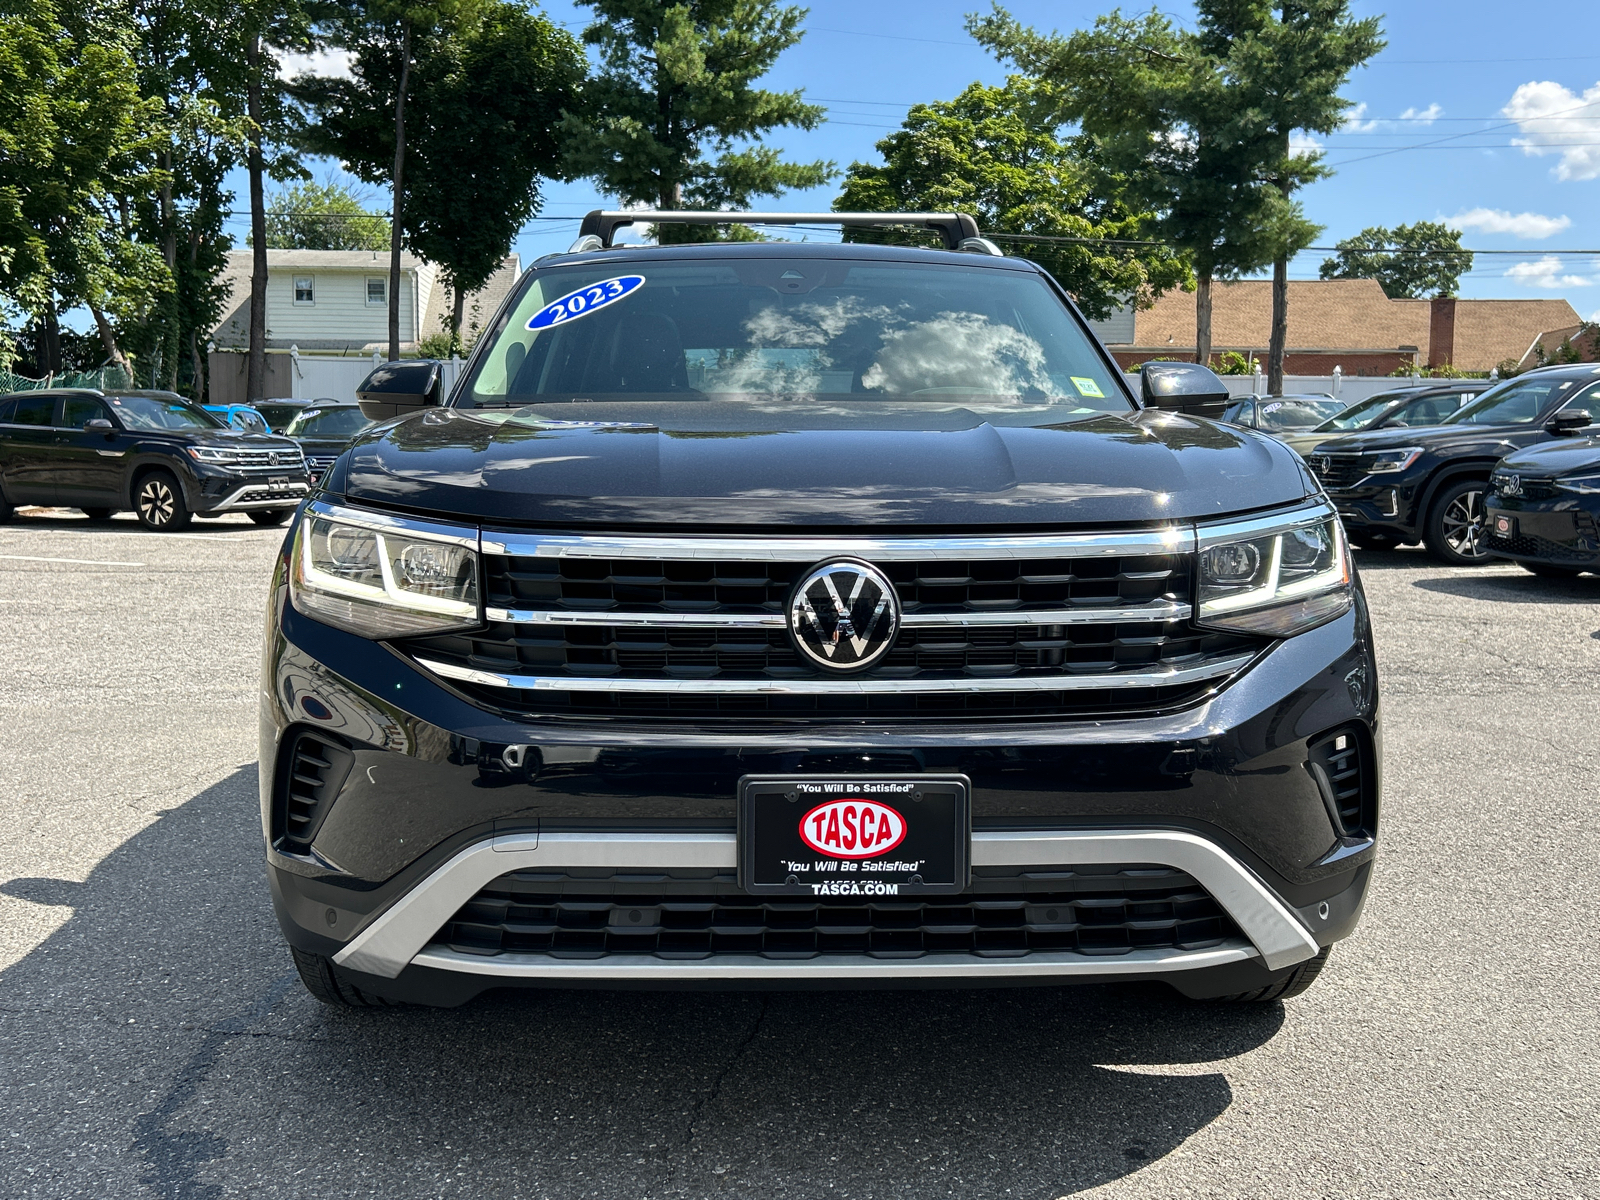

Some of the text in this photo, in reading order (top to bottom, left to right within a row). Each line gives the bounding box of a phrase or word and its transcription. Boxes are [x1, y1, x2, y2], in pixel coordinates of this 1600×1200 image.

[548, 279, 624, 324] 2023
[791, 562, 897, 669] VW
[824, 783, 844, 793] Will
[846, 784, 861, 793] Be
[812, 805, 893, 851] TASCA
[814, 860, 838, 872] Will
[840, 861, 858, 872] Be
[811, 883, 898, 896] TASCA.COM
